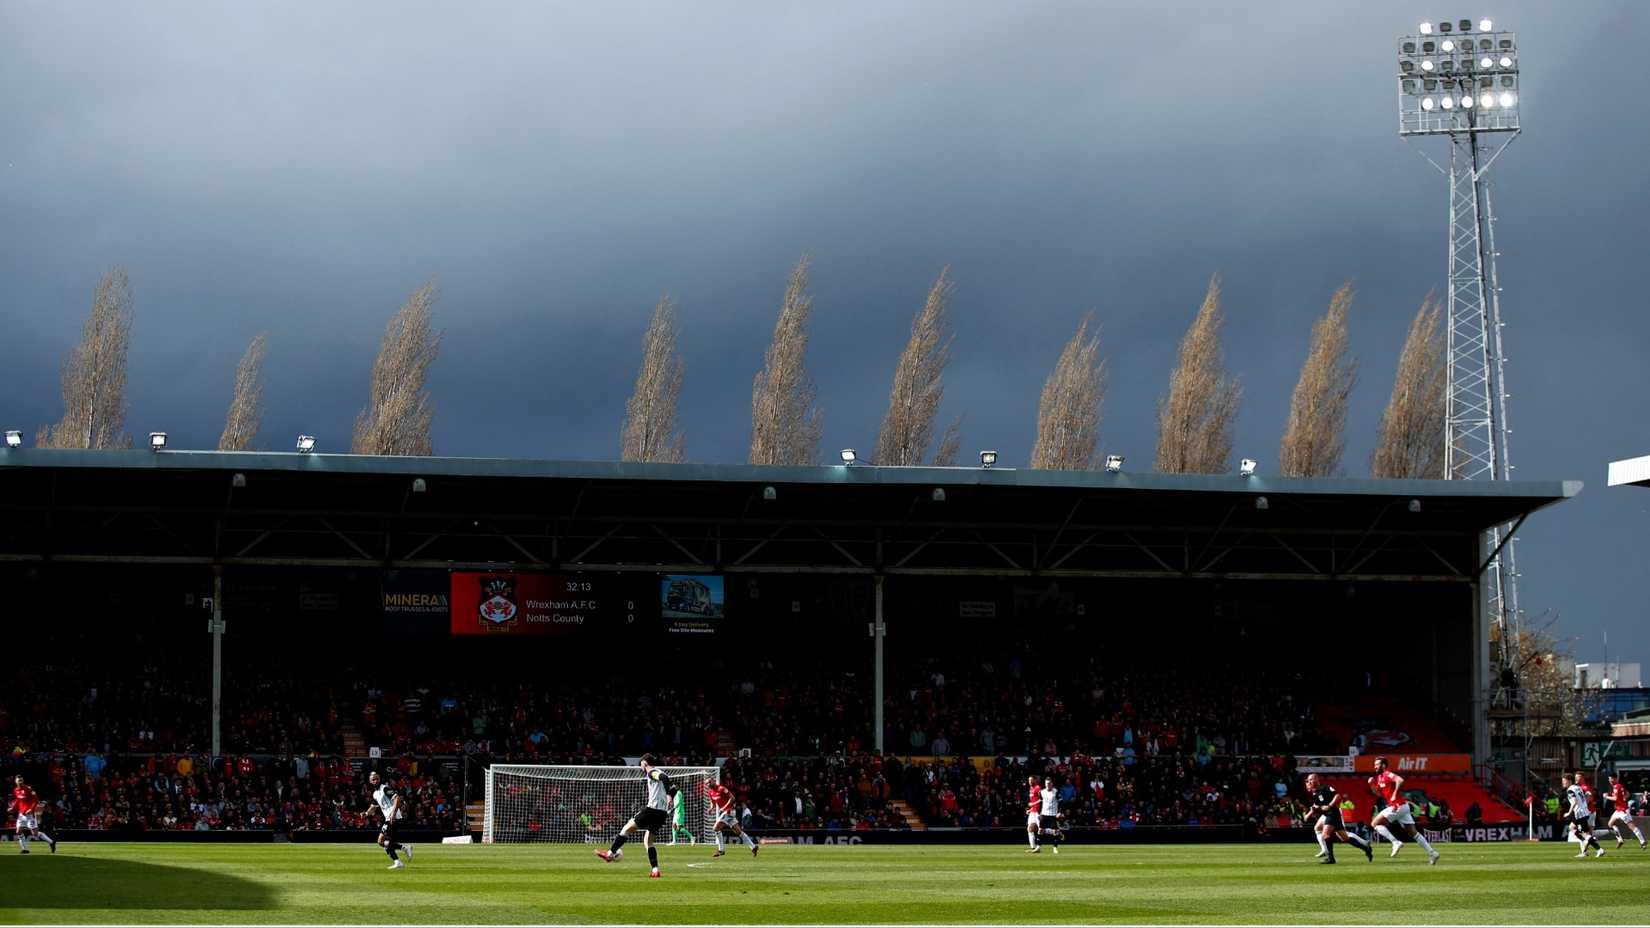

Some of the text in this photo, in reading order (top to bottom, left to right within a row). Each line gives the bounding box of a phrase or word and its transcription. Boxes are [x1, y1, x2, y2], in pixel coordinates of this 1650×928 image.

[566, 582, 592, 592] 32:13
[384, 593, 440, 606] MINERA
[526, 600, 570, 610] Wrexham
[526, 614, 551, 623] Notts
[552, 614, 585, 625] County
